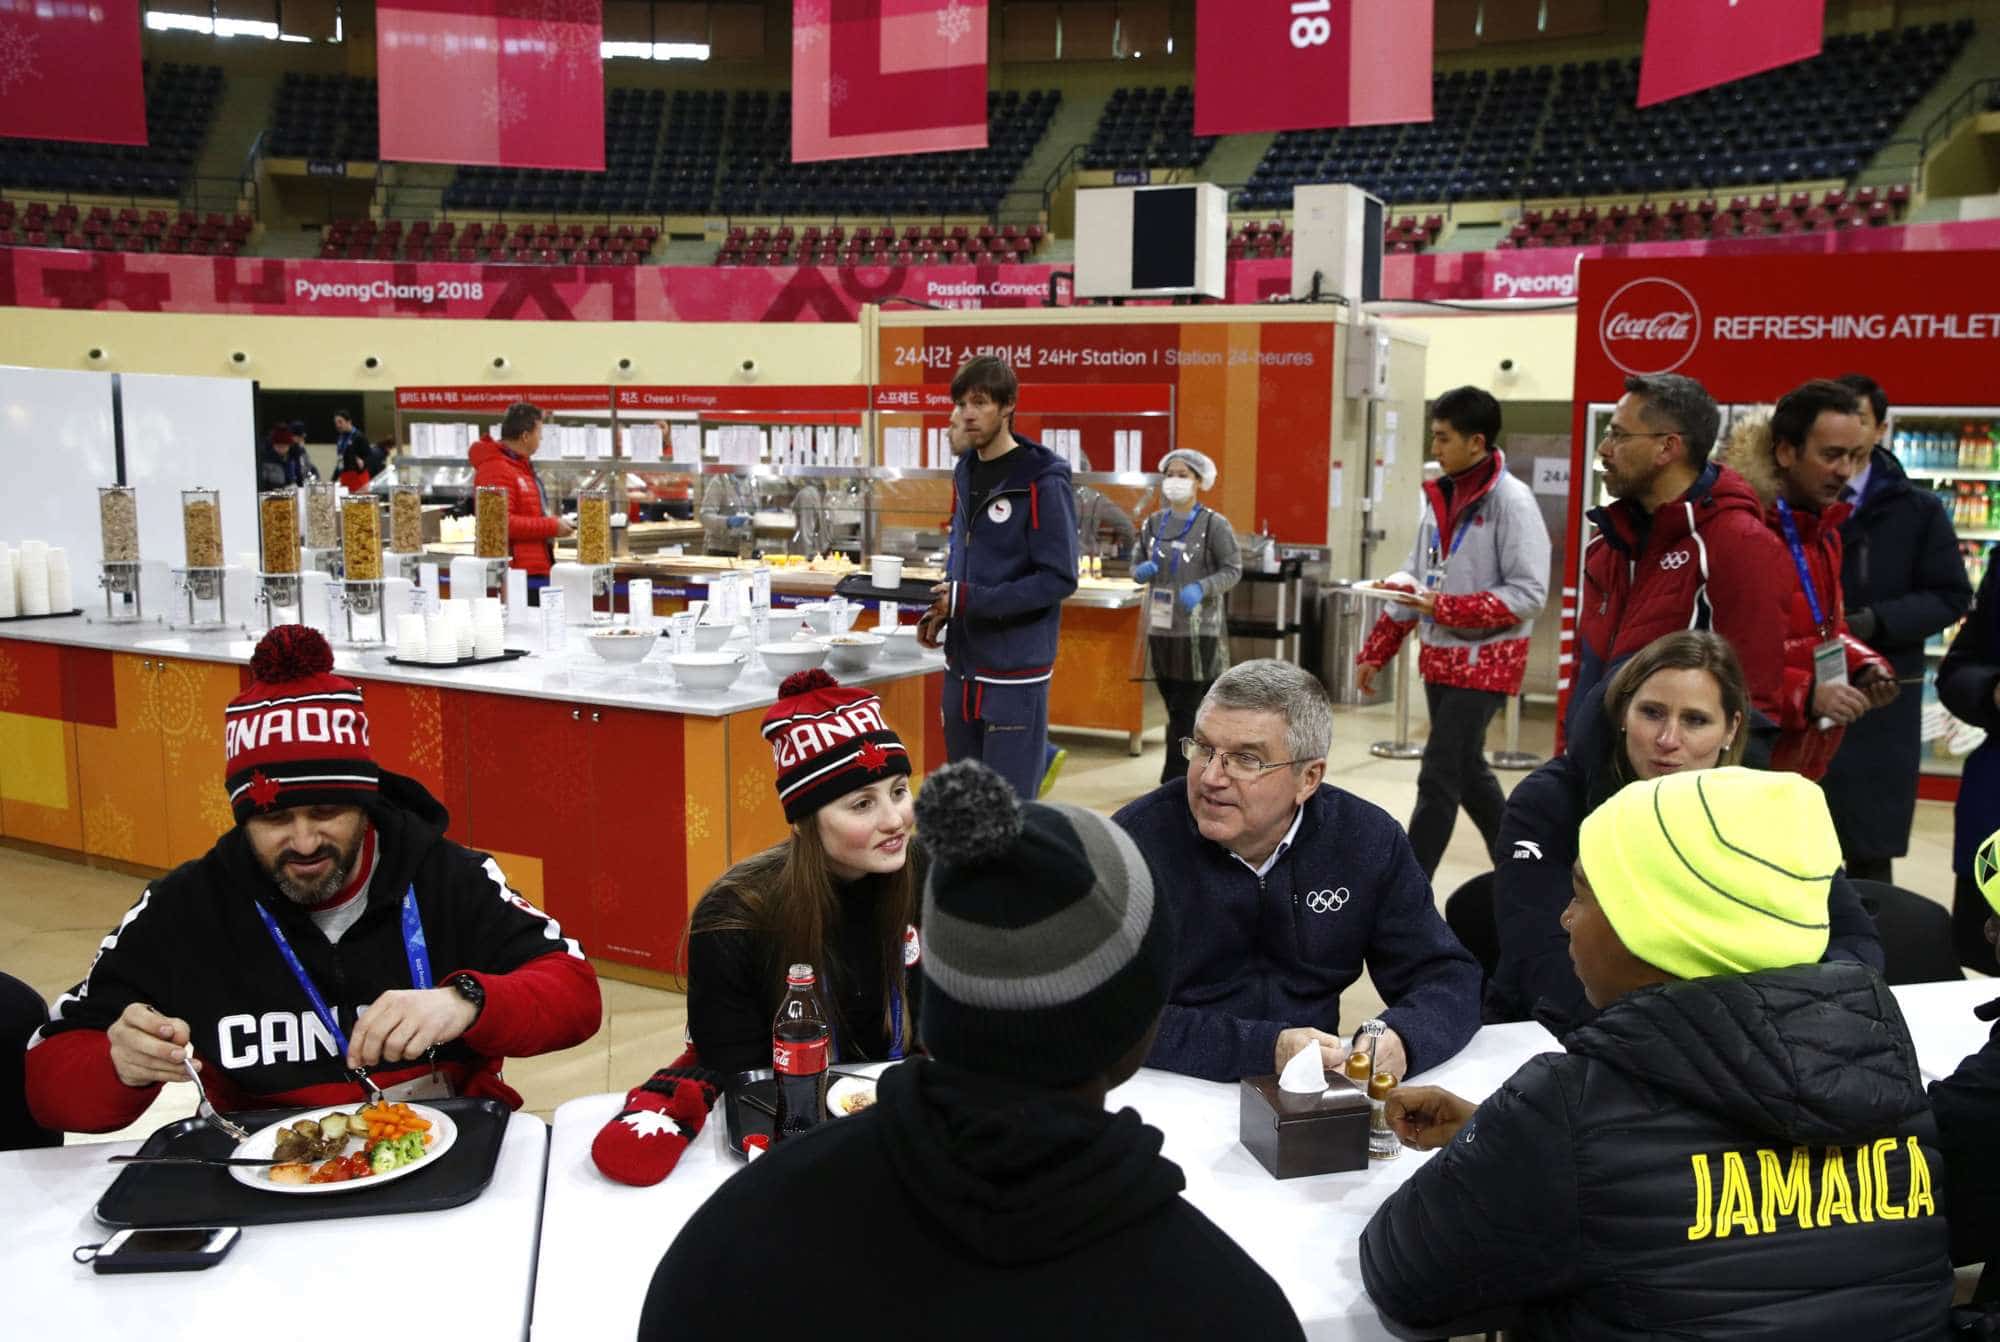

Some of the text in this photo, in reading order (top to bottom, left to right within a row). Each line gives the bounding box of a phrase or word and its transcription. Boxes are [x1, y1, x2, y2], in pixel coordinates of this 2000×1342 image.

[295, 280, 483, 303] PyeongChang 2018
[927, 281, 1069, 296] Passion. Connectd.
[1713, 315, 1884, 340] REFRESHING
[894, 345, 953, 368] 24시간
[1038, 349, 1076, 366] 24Hr
[1081, 349, 1147, 366] Station
[1164, 350, 1223, 366] Station
[877, 391, 920, 405] 스프레드
[1688, 1136, 1935, 1240] JAMAICA
